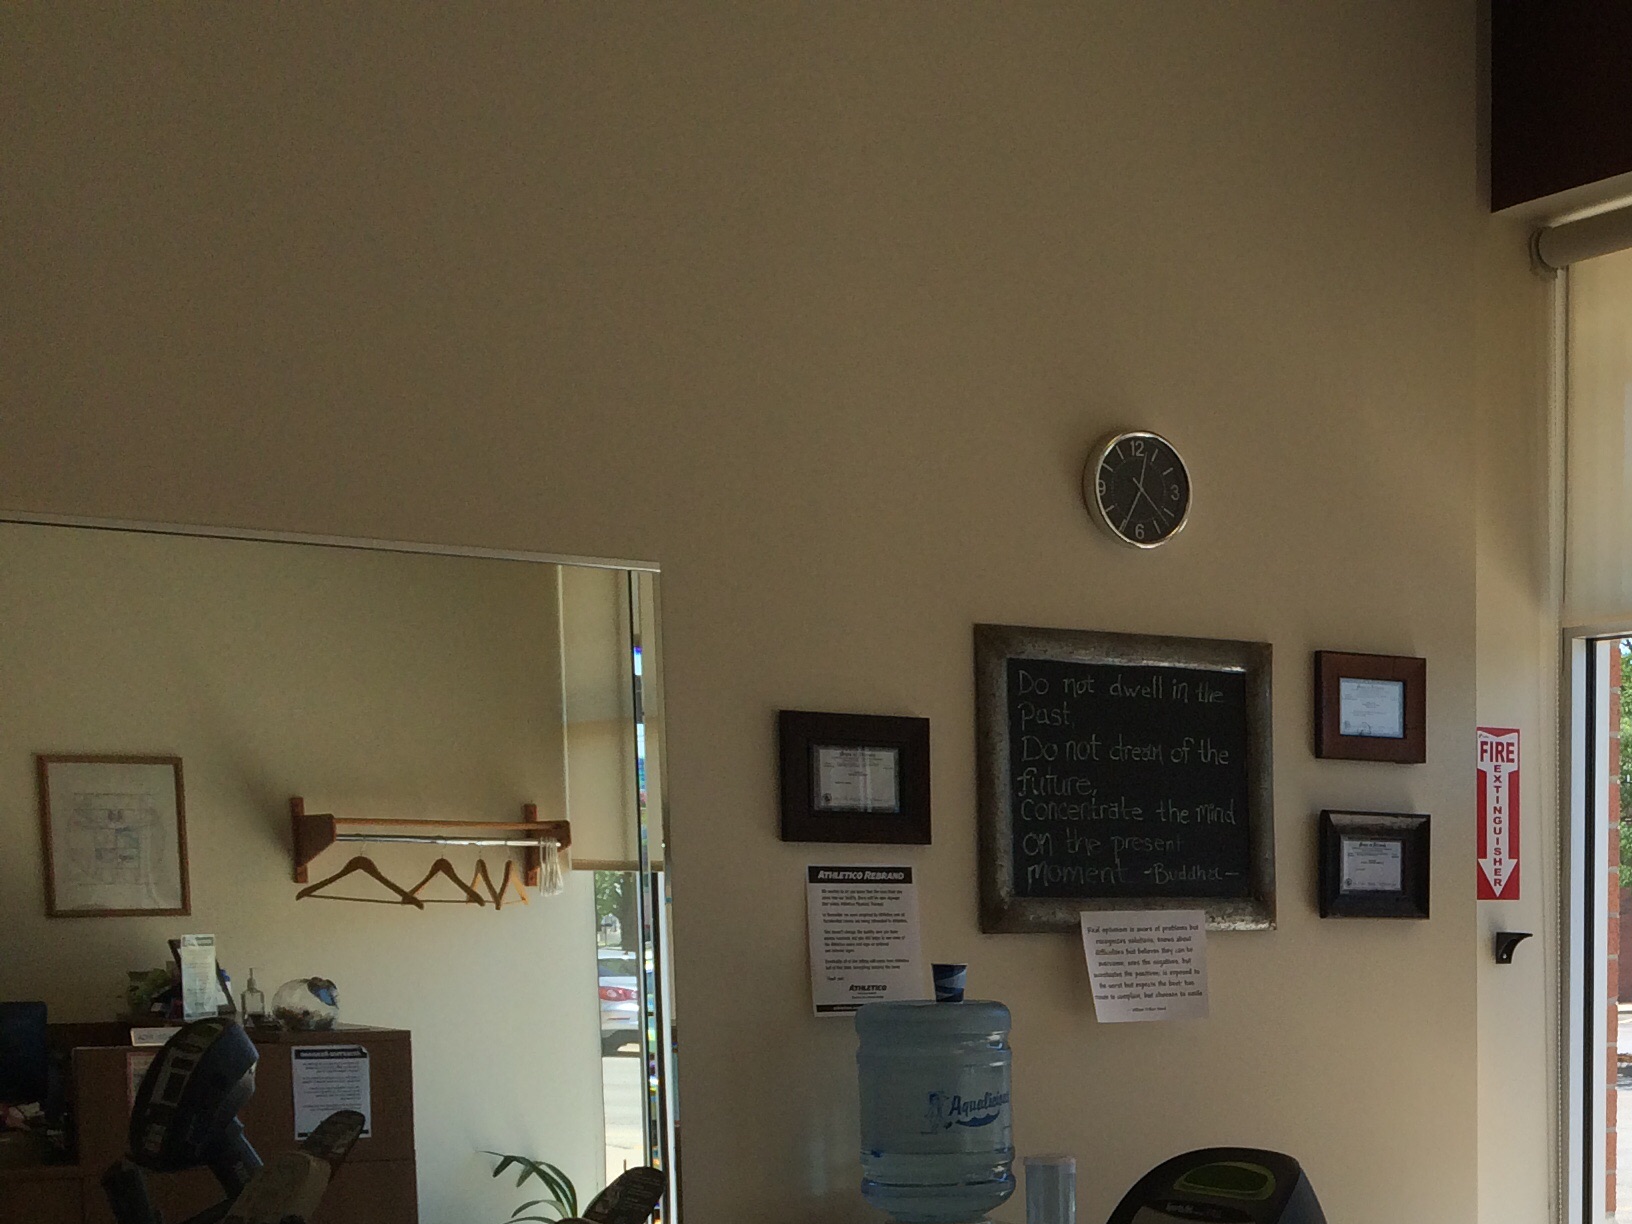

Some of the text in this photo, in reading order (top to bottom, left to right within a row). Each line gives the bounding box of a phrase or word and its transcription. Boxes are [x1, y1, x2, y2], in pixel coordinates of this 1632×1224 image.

[1130, 441, 1144, 456] 12
[1099, 480, 1106, 495] 9
[1170, 485, 1179, 500] 3
[1135, 524, 1144, 539] 6
[1017, 670, 1224, 703] Do not dwell in the
[1022, 736, 1058, 761] Do
[1066, 734, 1102, 761] not
[1171, 738, 1195, 764] of
[1198, 739, 1230, 765] the
[1480, 741, 1515, 763] FIRE
[1017, 768, 1098, 799] future,
[1156, 800, 1190, 824] the
[1493, 765, 1502, 886] EXTINGUISHER
[1066, 829, 1101, 856] the
[1111, 838, 1182, 861] present
[818, 871, 904, 880] ATHLETICO REBRAND
[849, 984, 887, 992] ATHLETICO
